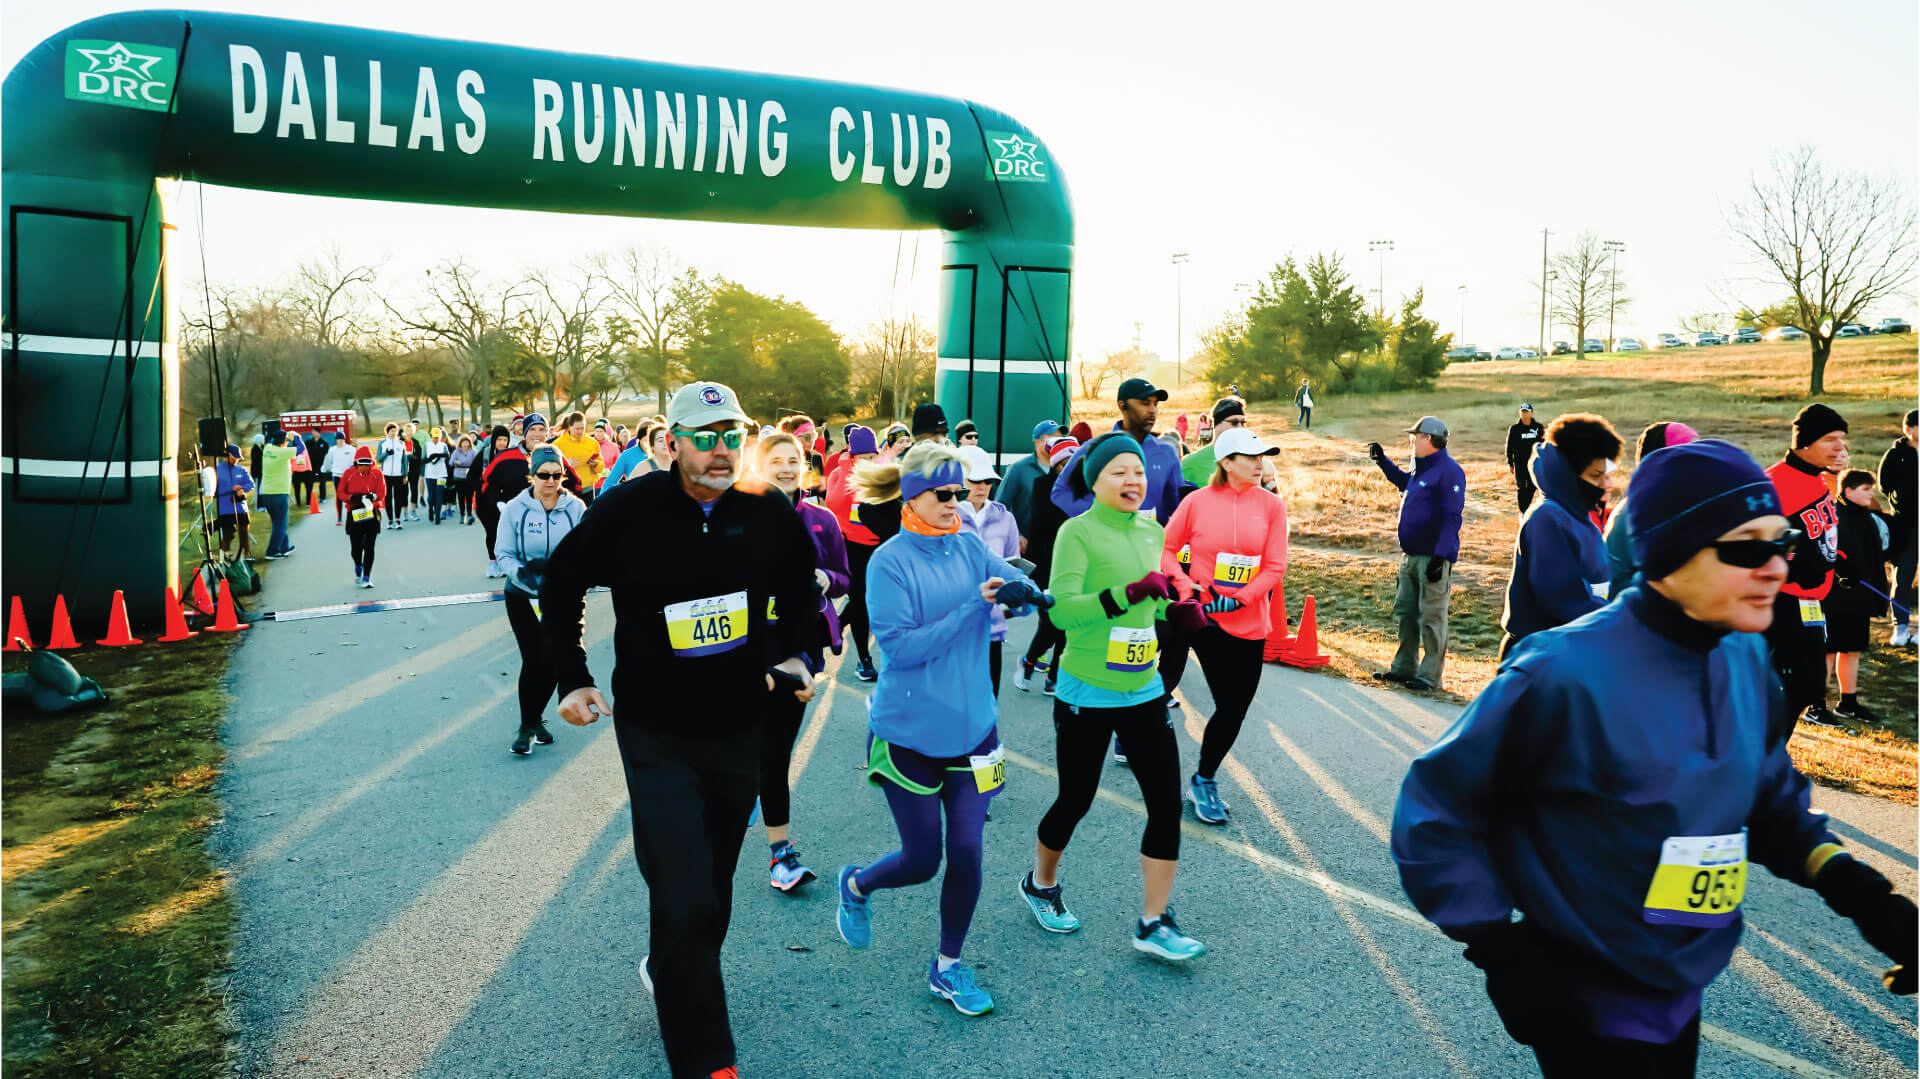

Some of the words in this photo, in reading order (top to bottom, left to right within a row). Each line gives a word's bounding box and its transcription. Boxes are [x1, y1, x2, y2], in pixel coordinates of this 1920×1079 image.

[78, 71, 168, 105] DRC
[229, 43, 487, 155] DALLAS
[532, 78, 789, 178] RUNNING
[828, 106, 952, 190] CLUB
[994, 158, 1046, 177] DRC
[1227, 565, 1252, 583] 971
[693, 615, 732, 644] 446
